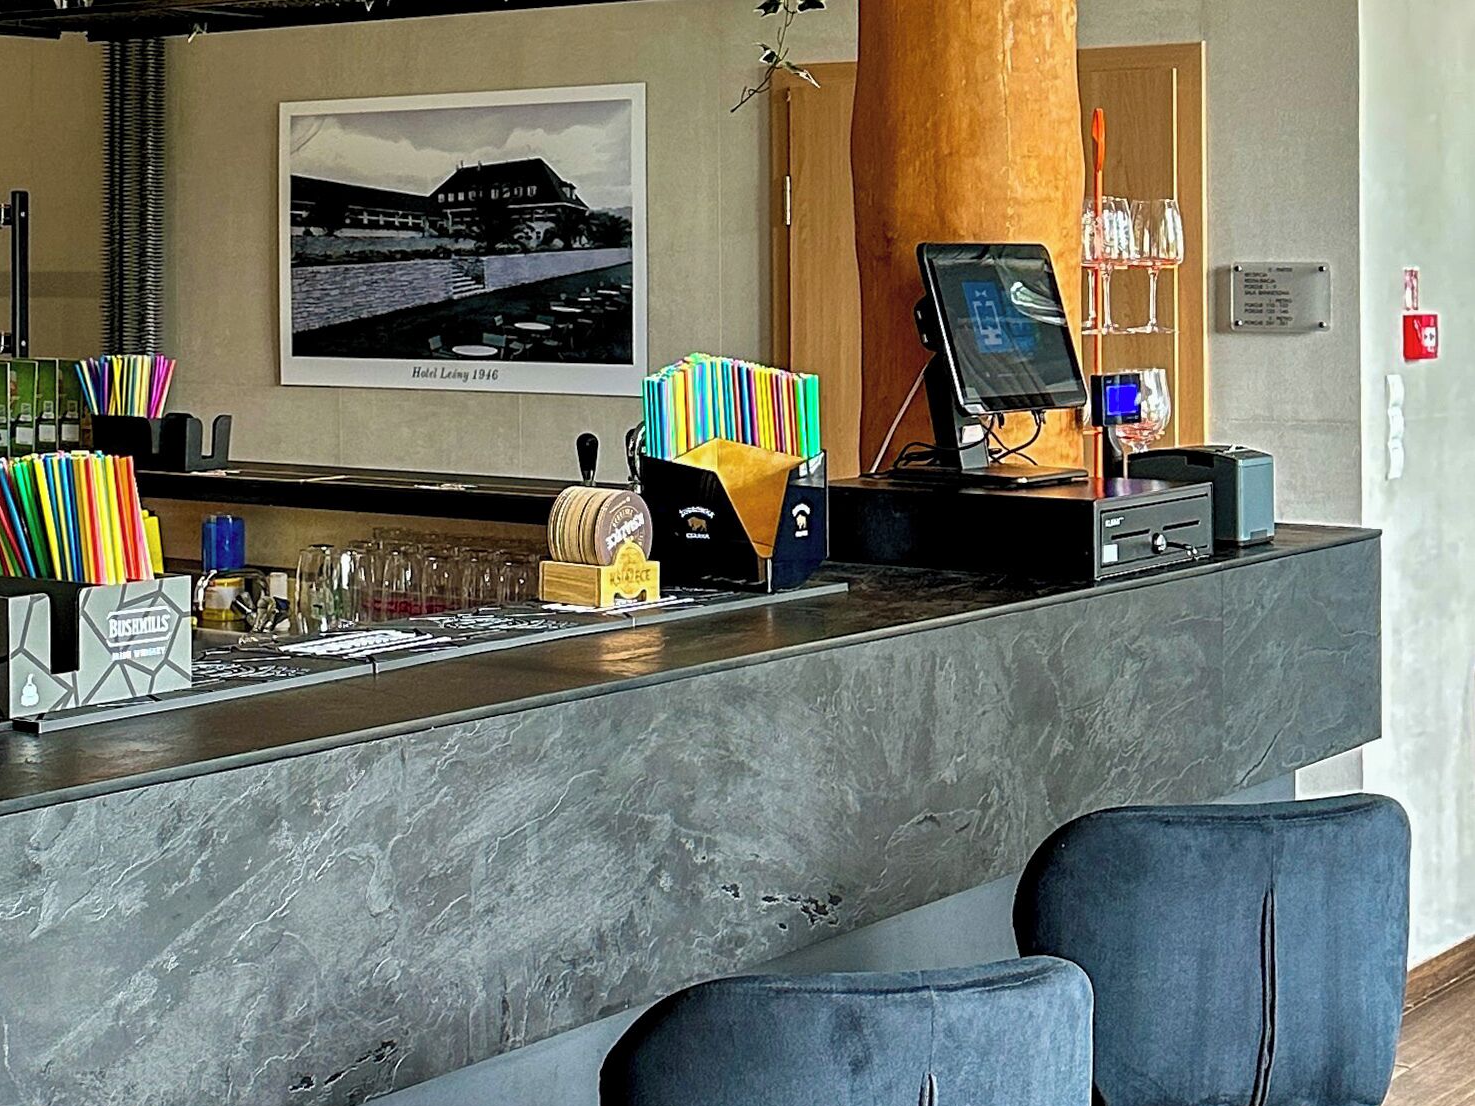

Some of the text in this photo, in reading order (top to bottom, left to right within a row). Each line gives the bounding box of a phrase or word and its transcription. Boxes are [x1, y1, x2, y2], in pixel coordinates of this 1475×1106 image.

[412, 366, 438, 378] Hotel
[472, 368, 499, 380] 1946
[108, 614, 170, 638] BUSHMILLS
